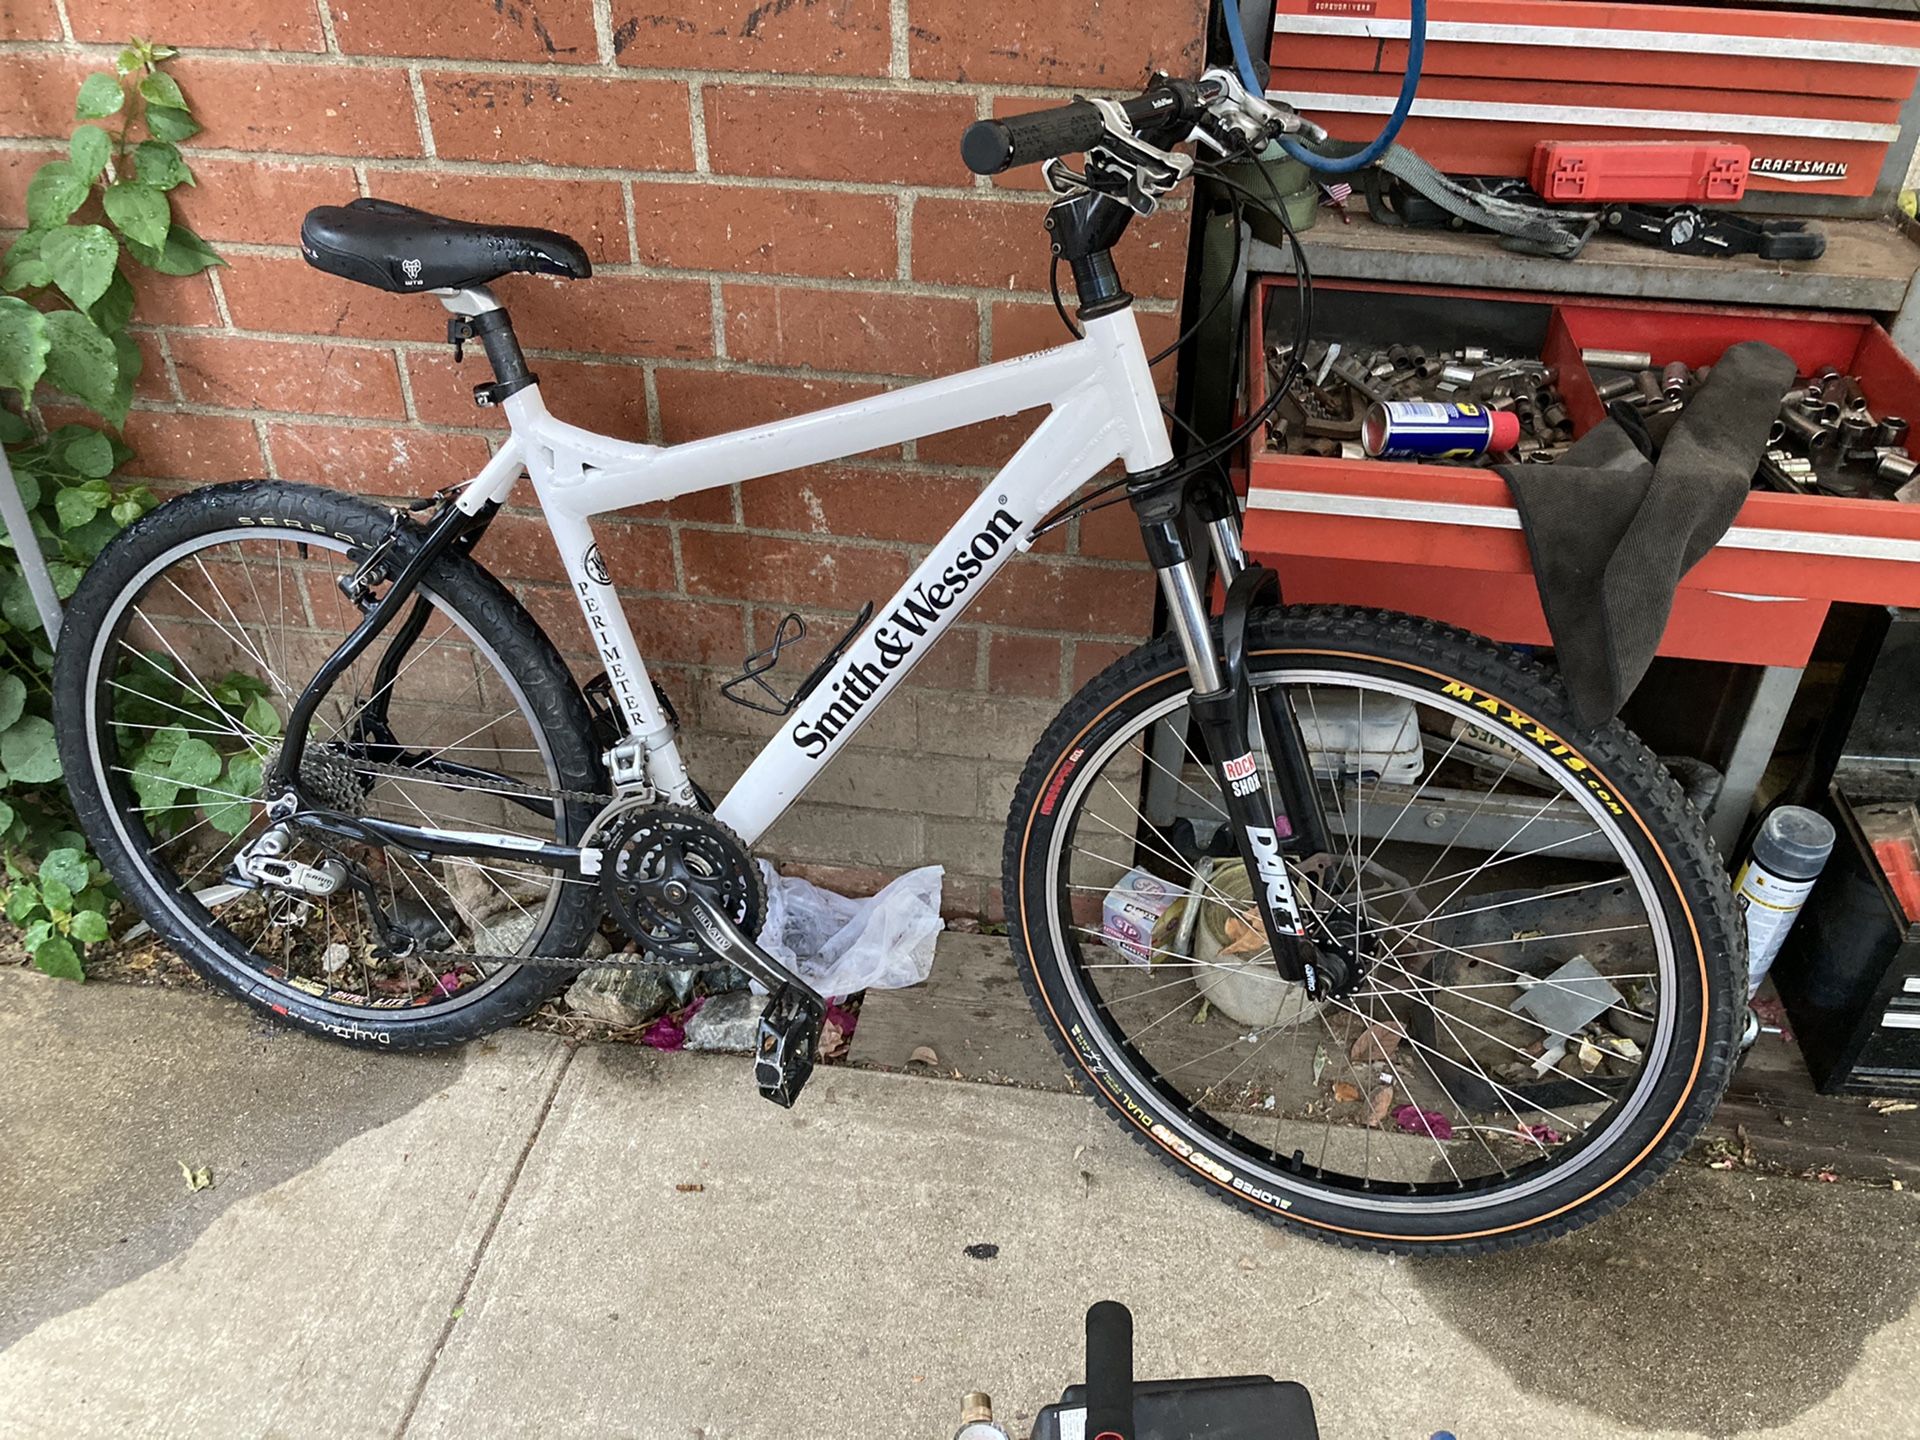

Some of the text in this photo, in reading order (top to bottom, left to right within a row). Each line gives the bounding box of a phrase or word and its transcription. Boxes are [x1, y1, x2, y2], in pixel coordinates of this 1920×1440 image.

[1750, 157, 1848, 175] CRAFTSMAN
[792, 508, 1023, 760] Smith & Wesson
[577, 581, 646, 727] PERIMETER
[1226, 756, 1255, 778] ROCK
[1231, 777, 1261, 798] SHOX
[692, 905, 732, 950] TRUVATIV
[1115, 919, 1138, 937] STP
[316, 1021, 390, 1044] Drifter
[1122, 1093, 1154, 1127] DUAL
